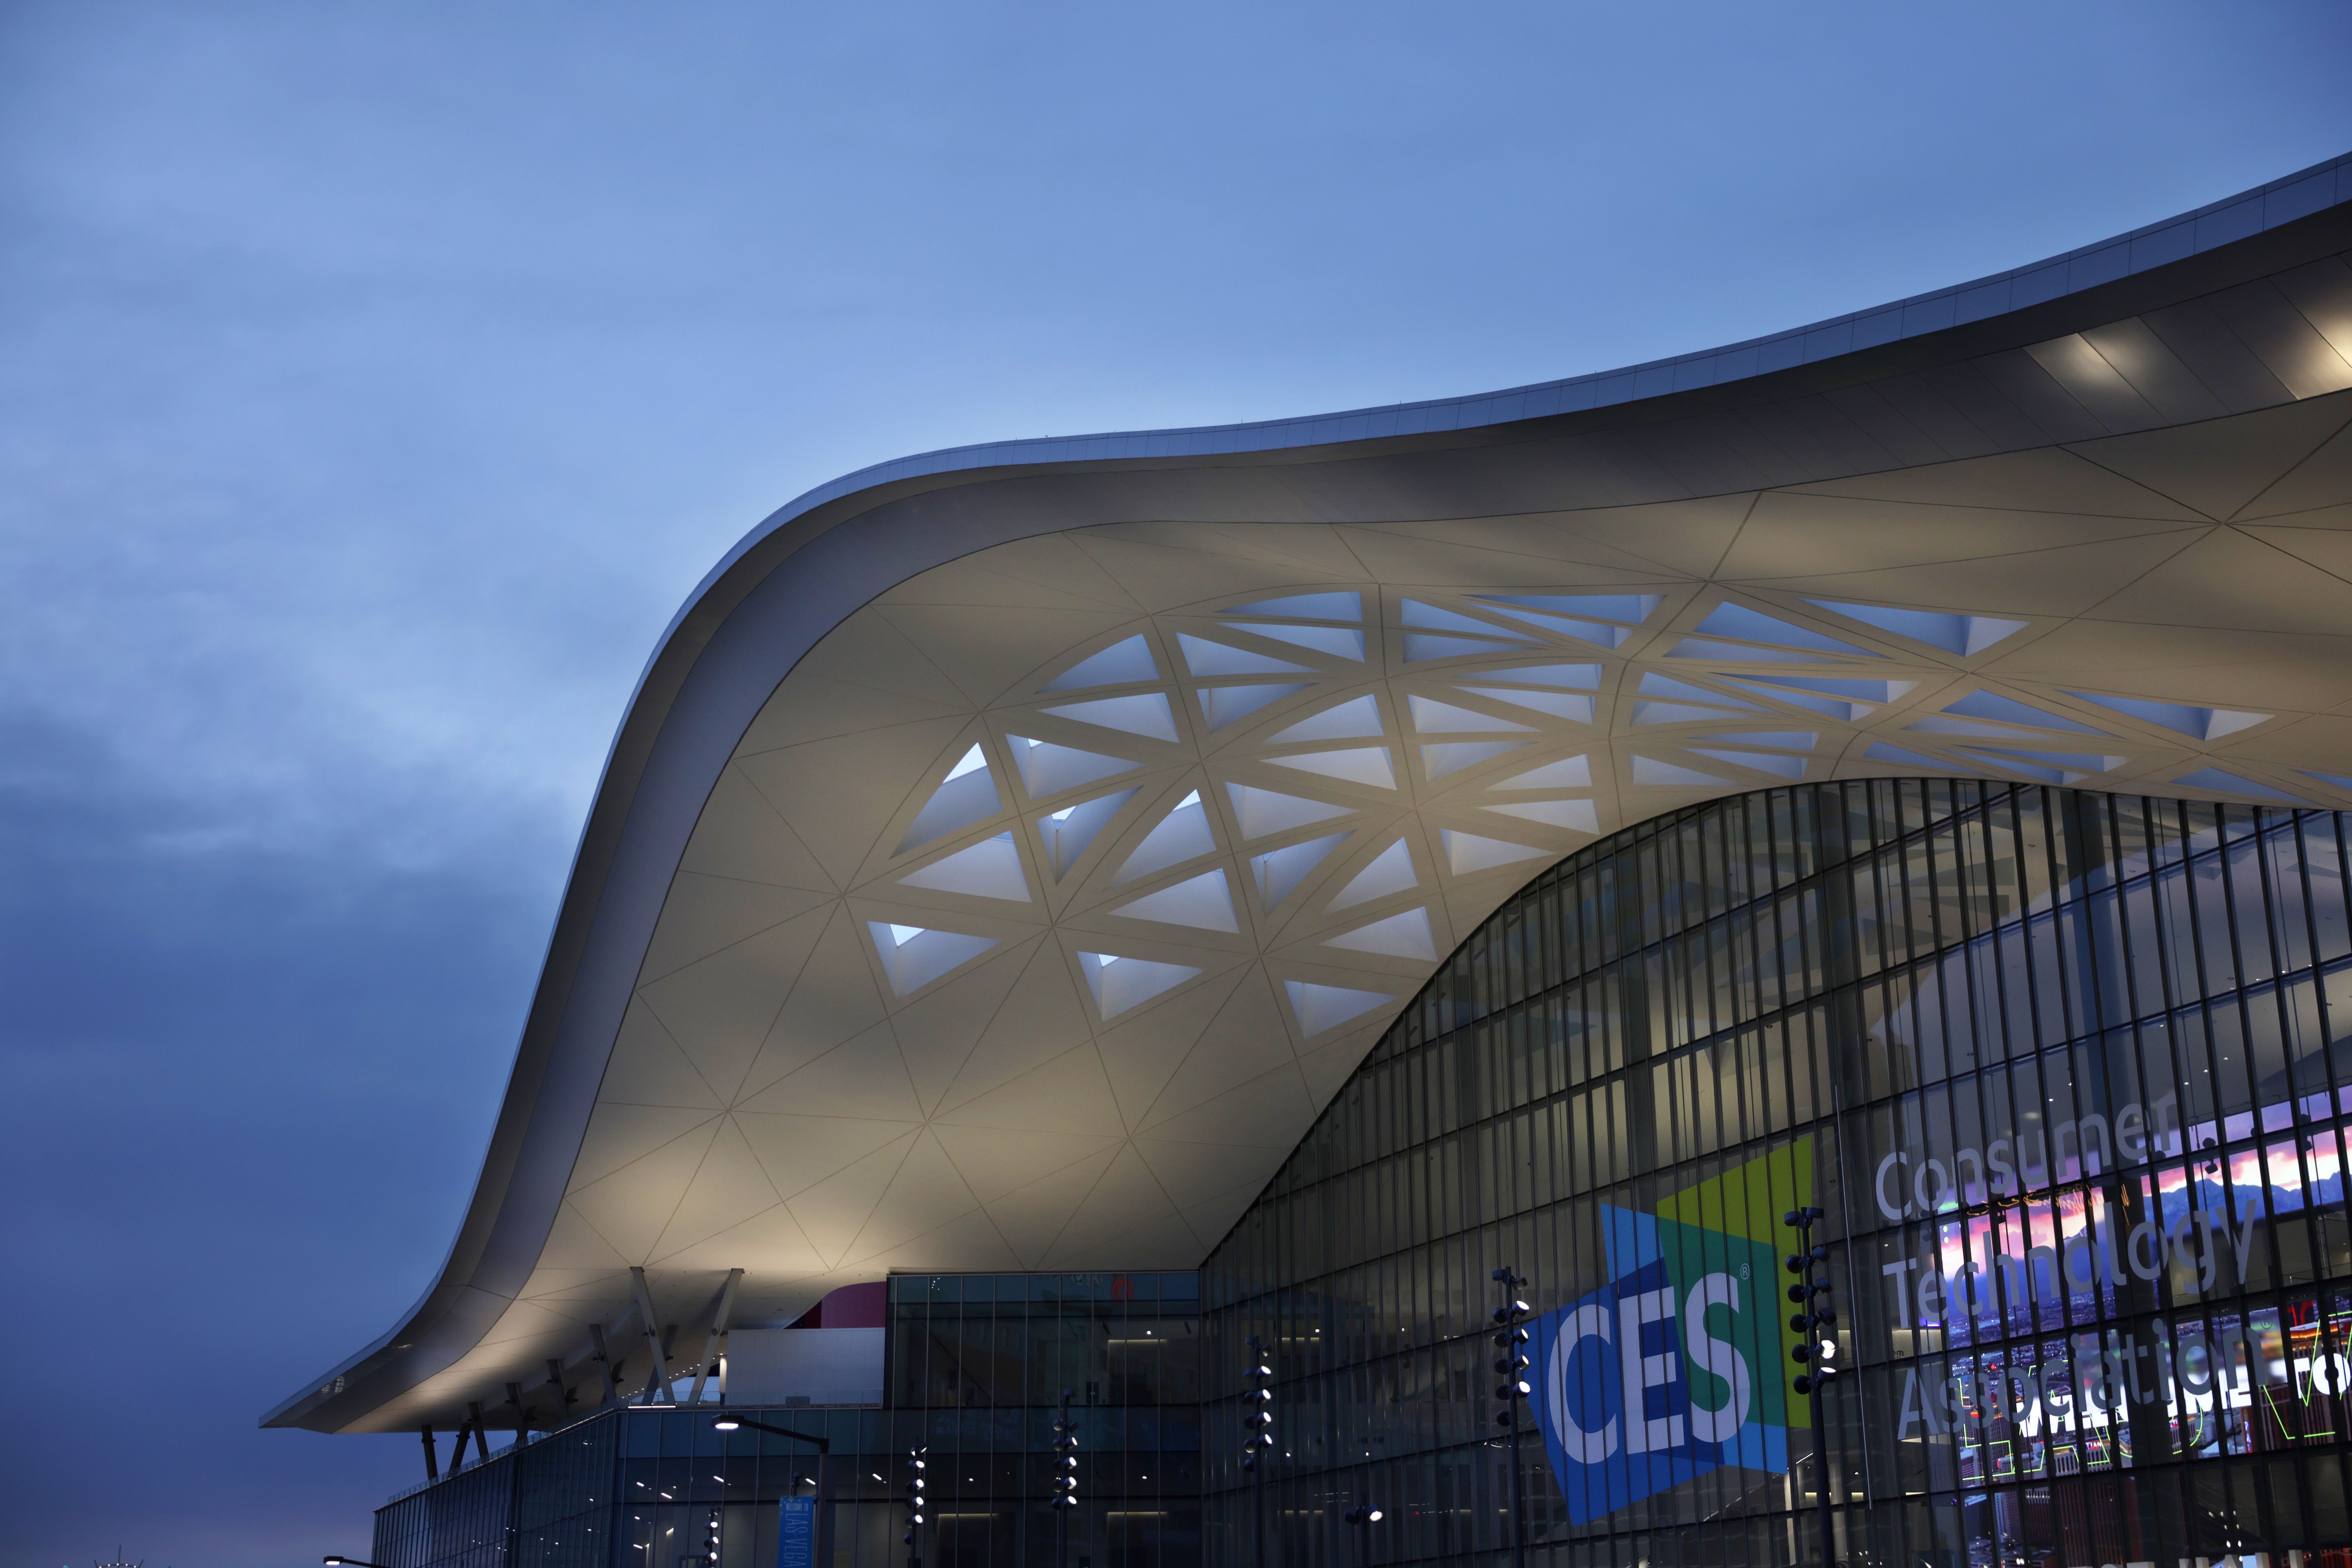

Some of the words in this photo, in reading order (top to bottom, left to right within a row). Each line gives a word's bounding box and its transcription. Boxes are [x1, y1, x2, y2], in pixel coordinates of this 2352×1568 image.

[1876, 1091, 2176, 1220] Consumer
[1882, 1198, 2257, 1328] Technology
[785, 1513, 808, 1533] LAS
[786, 1503, 803, 1511] WELCOME
[804, 1503, 809, 1511] TO
